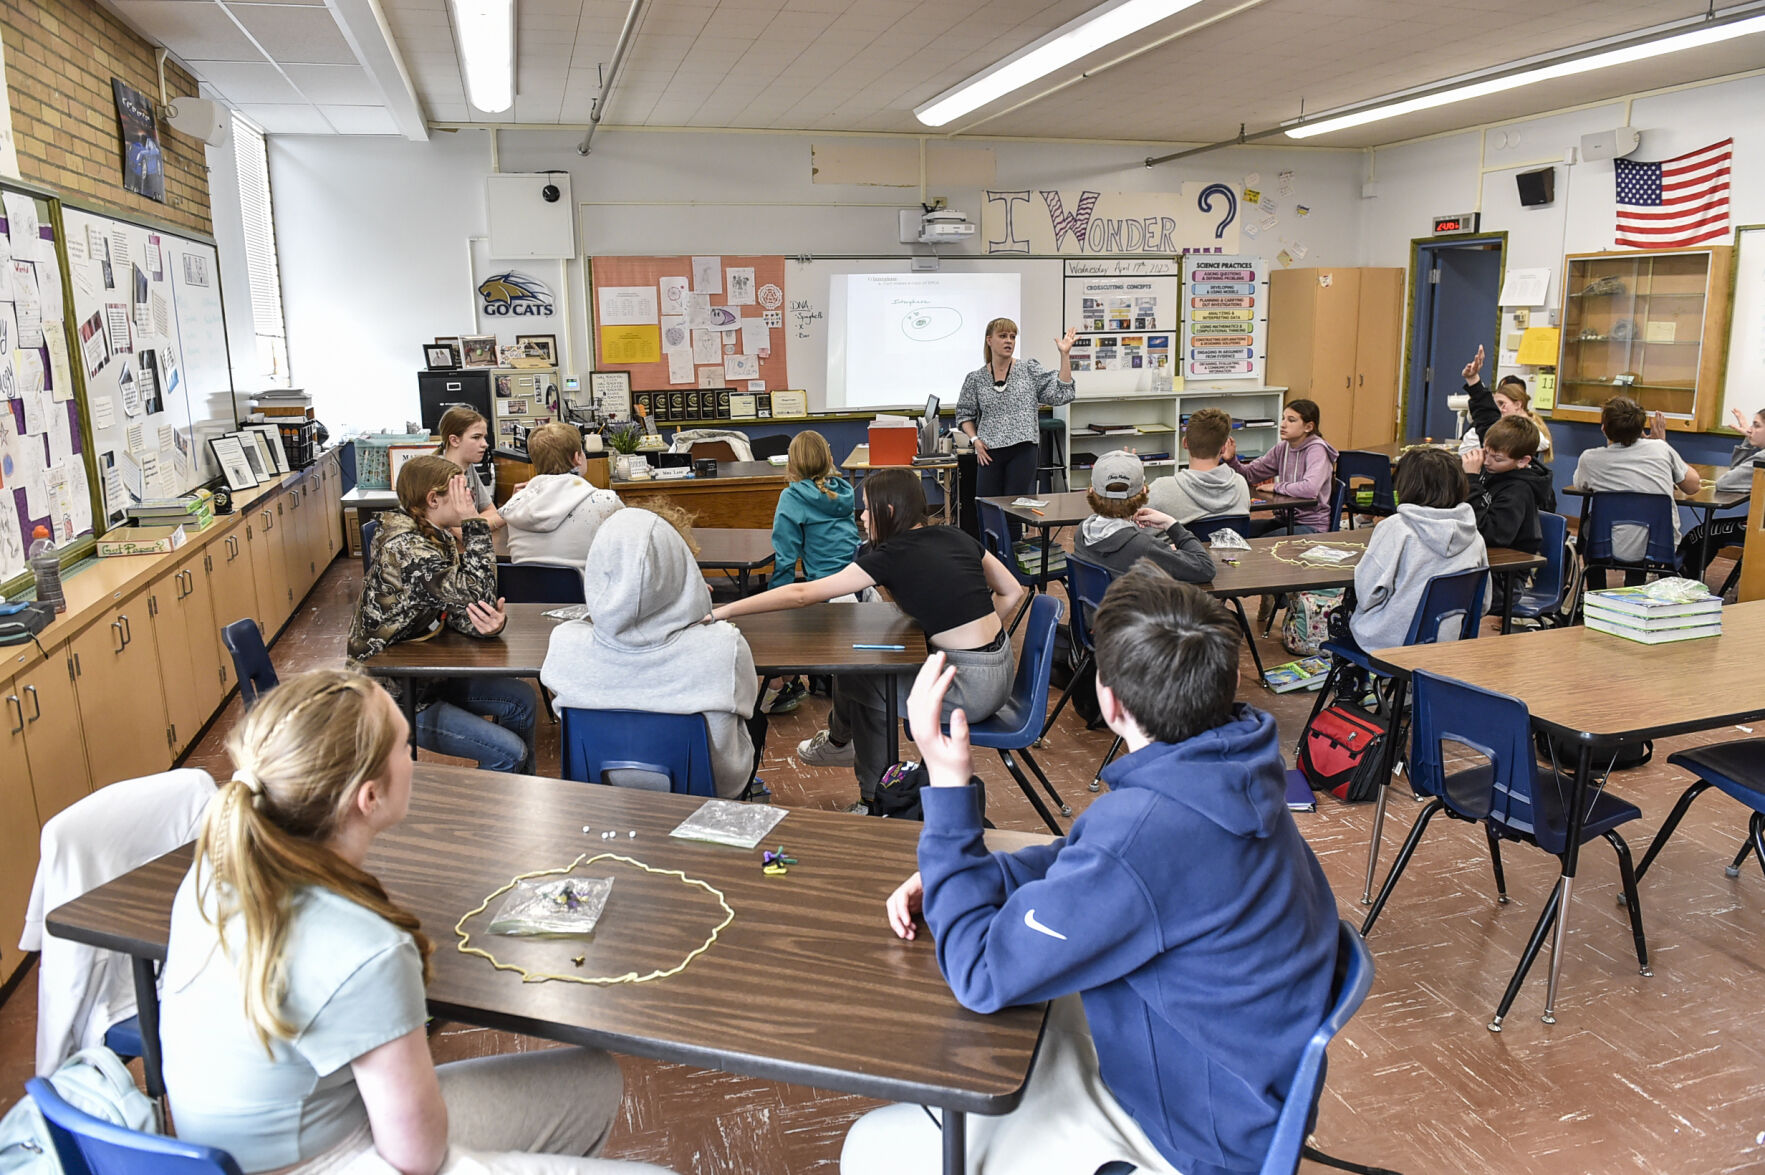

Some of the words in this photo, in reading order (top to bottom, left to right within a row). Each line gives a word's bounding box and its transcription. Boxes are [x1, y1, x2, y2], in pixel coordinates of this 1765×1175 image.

[986, 190, 1031, 254] I
[1039, 190, 1178, 253] WONDER
[1068, 262, 1110, 275] Wednesday
[1114, 260, 1131, 275] April
[484, 304, 510, 316] GO
[512, 304, 554, 316] CATS
[1541, 377, 1554, 389] 11
[124, 540, 165, 555] Paper?
